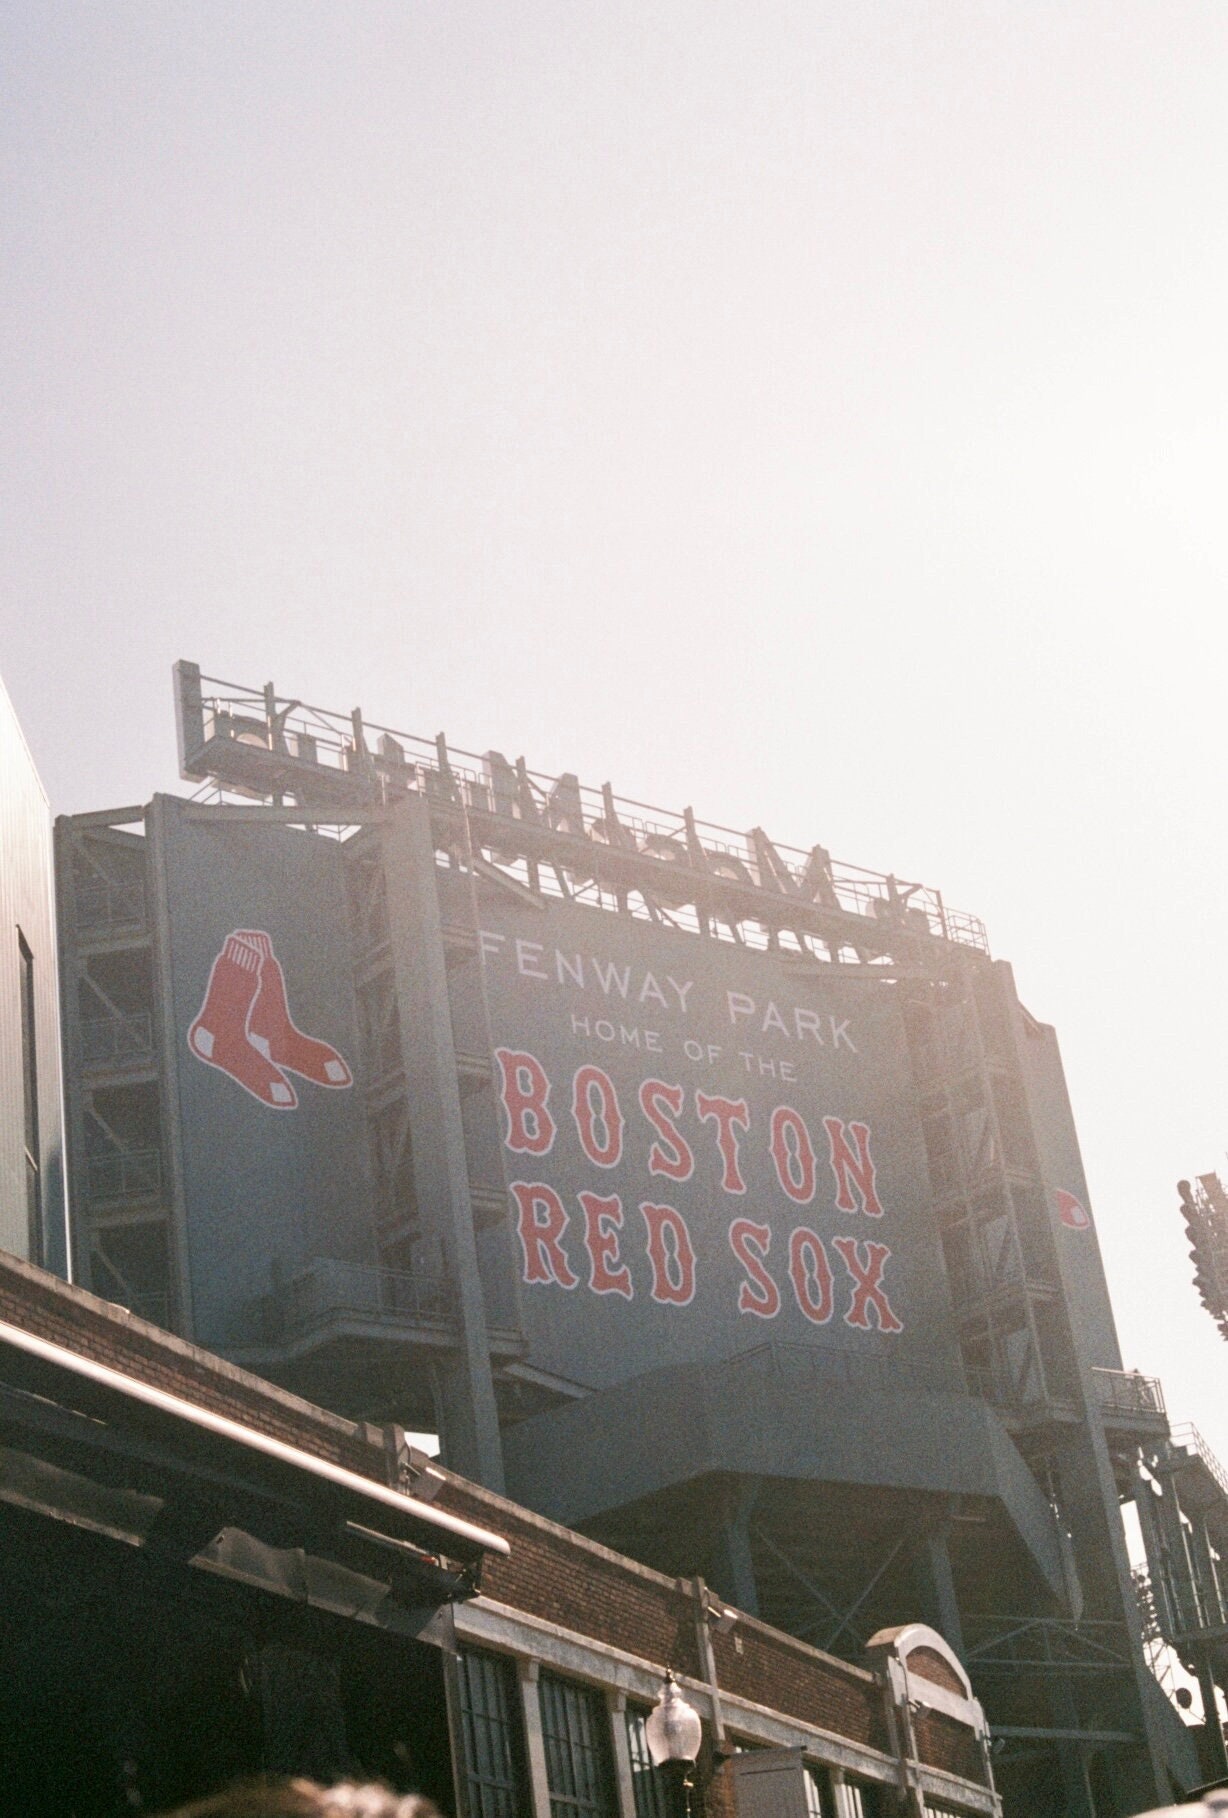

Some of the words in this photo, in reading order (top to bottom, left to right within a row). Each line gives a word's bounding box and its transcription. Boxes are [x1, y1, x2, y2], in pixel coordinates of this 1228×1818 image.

[479, 931, 694, 1013] FENWAY
[727, 990, 857, 1053] PARK
[571, 1015, 663, 1053] HOME
[683, 1040, 722, 1065] OF
[739, 1052, 797, 1083] THE
[494, 1047, 884, 1218] BOSTON
[510, 1181, 697, 1307] RED
[729, 1218, 904, 1333] SOX
